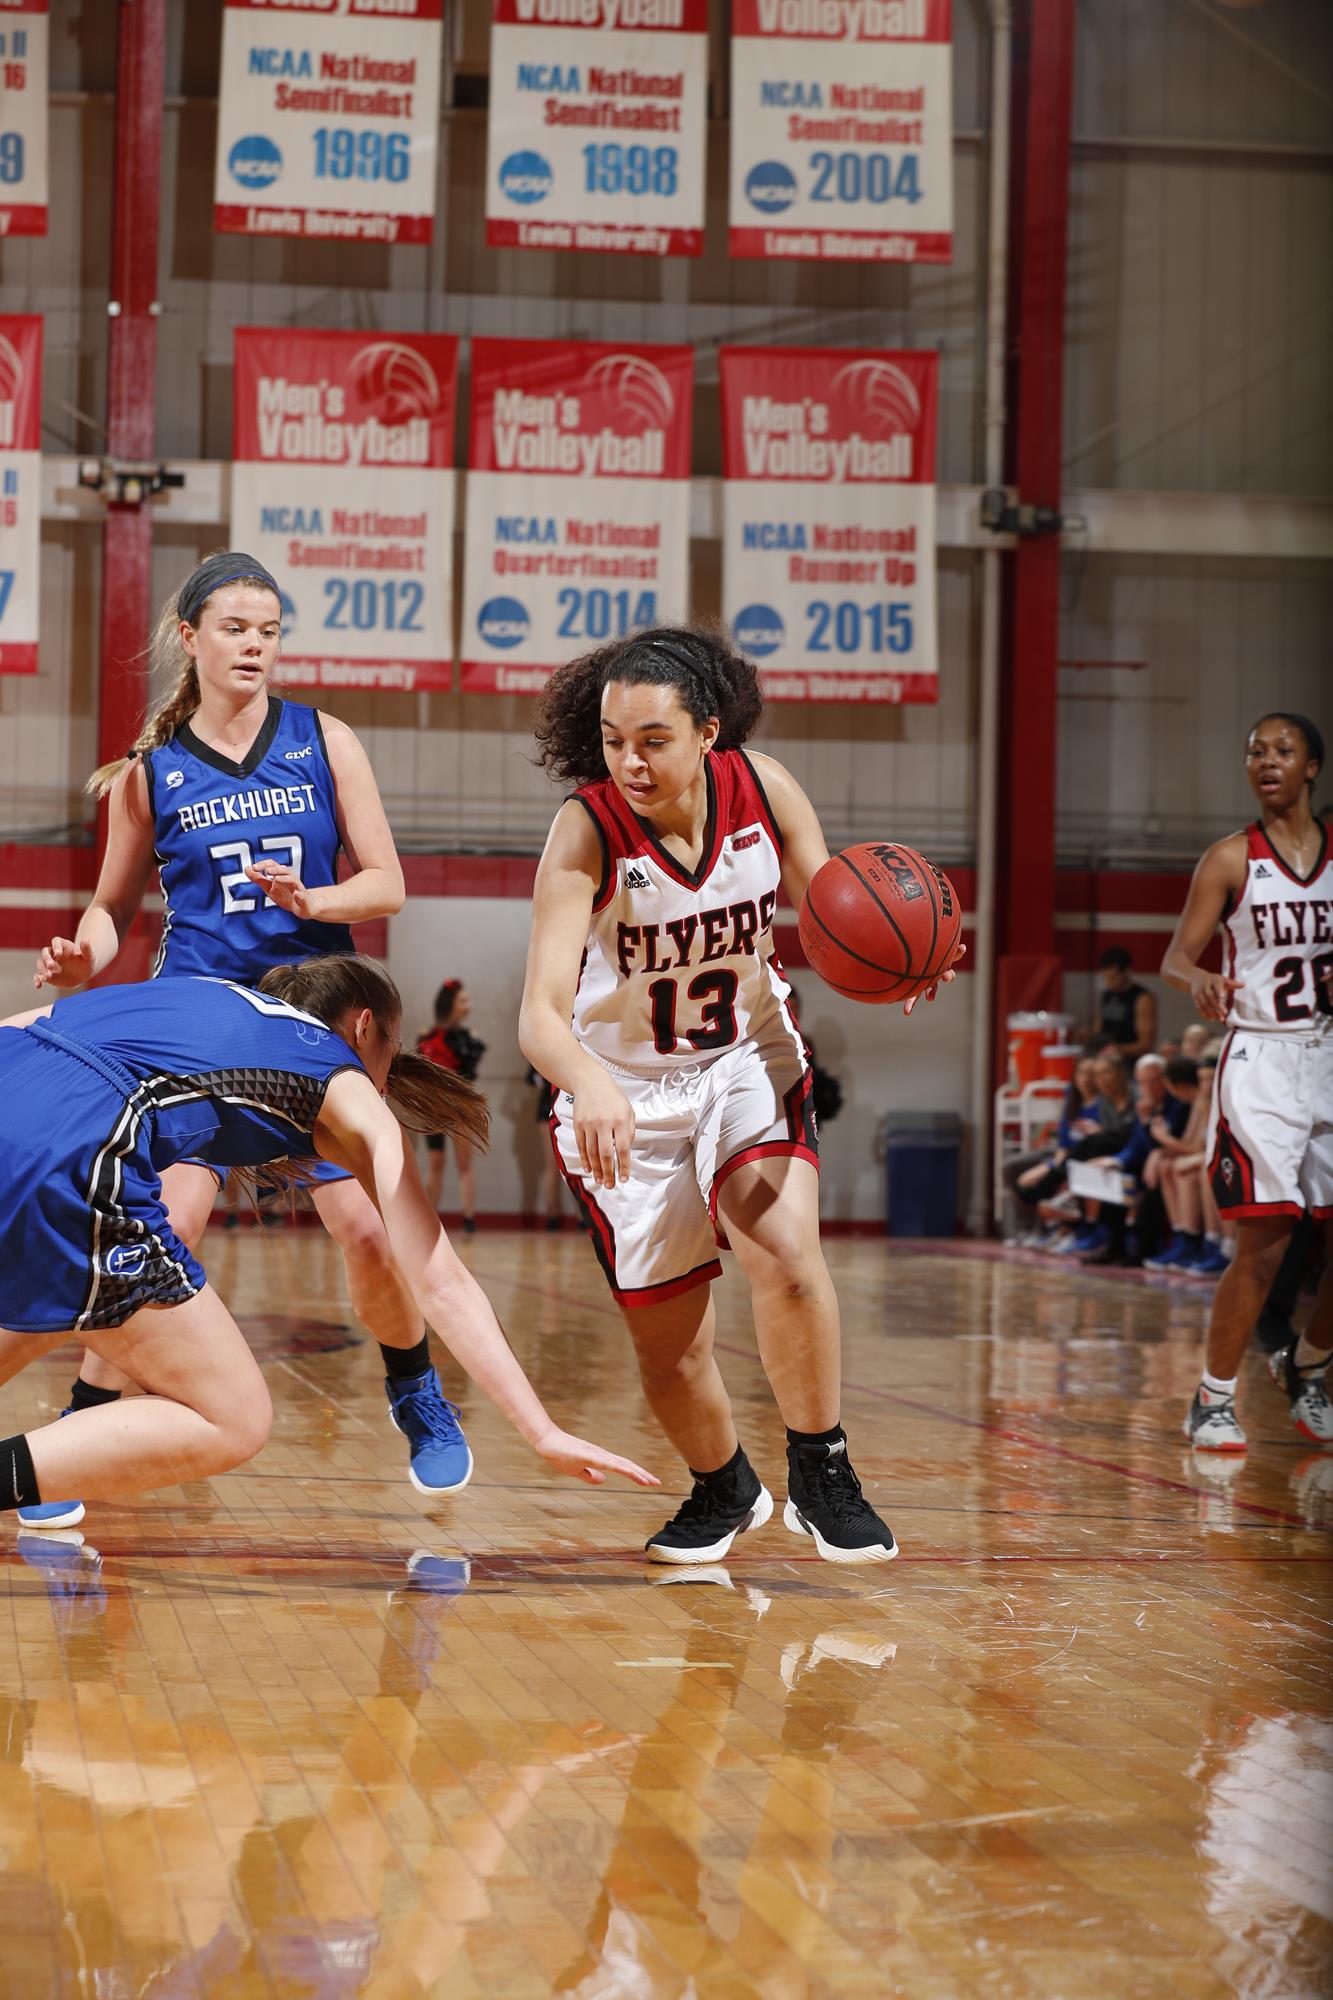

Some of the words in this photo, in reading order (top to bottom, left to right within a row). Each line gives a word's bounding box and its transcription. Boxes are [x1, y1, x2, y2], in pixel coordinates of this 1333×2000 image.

[249, 48, 312, 78] NCAA
[319, 53, 416, 84] National
[517, 63, 580, 93] NCAA
[588, 66, 684, 98] National
[275, 82, 413, 118] Semifinalist
[760, 81, 823, 108] NCAA
[830, 84, 925, 112] National
[544, 97, 682, 133] Semifinalist
[788, 113, 924, 145] Semifinalist
[312, 128, 411, 183] 1996
[582, 143, 679, 197] 1998
[810, 151, 923, 205] 2004
[246, 207, 300, 232] Lewis
[303, 210, 399, 242] University
[519, 221, 572, 246] Lewis
[575, 225, 670, 256] University
[764, 231, 818, 256] Lewis
[821, 233, 917, 260] University
[257, 375, 345, 417] Men's
[494, 388, 581, 429] Men's
[743, 396, 829, 434] Men's
[257, 415, 430, 467] Volleyball
[494, 425, 665, 478] Volleyball
[744, 432, 913, 483] Volleyball
[260, 507, 323, 534] NCAA
[331, 510, 427, 537] National
[495, 515, 557, 544] NCAA
[566, 519, 661, 548] National
[743, 523, 807, 549] NCAA
[813, 525, 916, 553] National
[288, 539, 425, 571] Semifinalist
[493, 548, 657, 579] Quarterfinalist
[788, 555, 878, 583] Runner
[884, 558, 916, 587] Up
[323, 577, 425, 631] 2012
[558, 587, 657, 638] 2014
[806, 601, 914, 654] 2015
[273, 663, 317, 686] ewis
[320, 660, 417, 691] University
[762, 677, 805, 700] ewis
[808, 677, 903, 704] University
[284, 746, 313, 760] GLVC
[177, 783, 317, 833] ROCKHURST
[617, 889, 777, 979] FLYERS
[1251, 900, 1333, 949] FLYE
[648, 968, 739, 1054] 13
